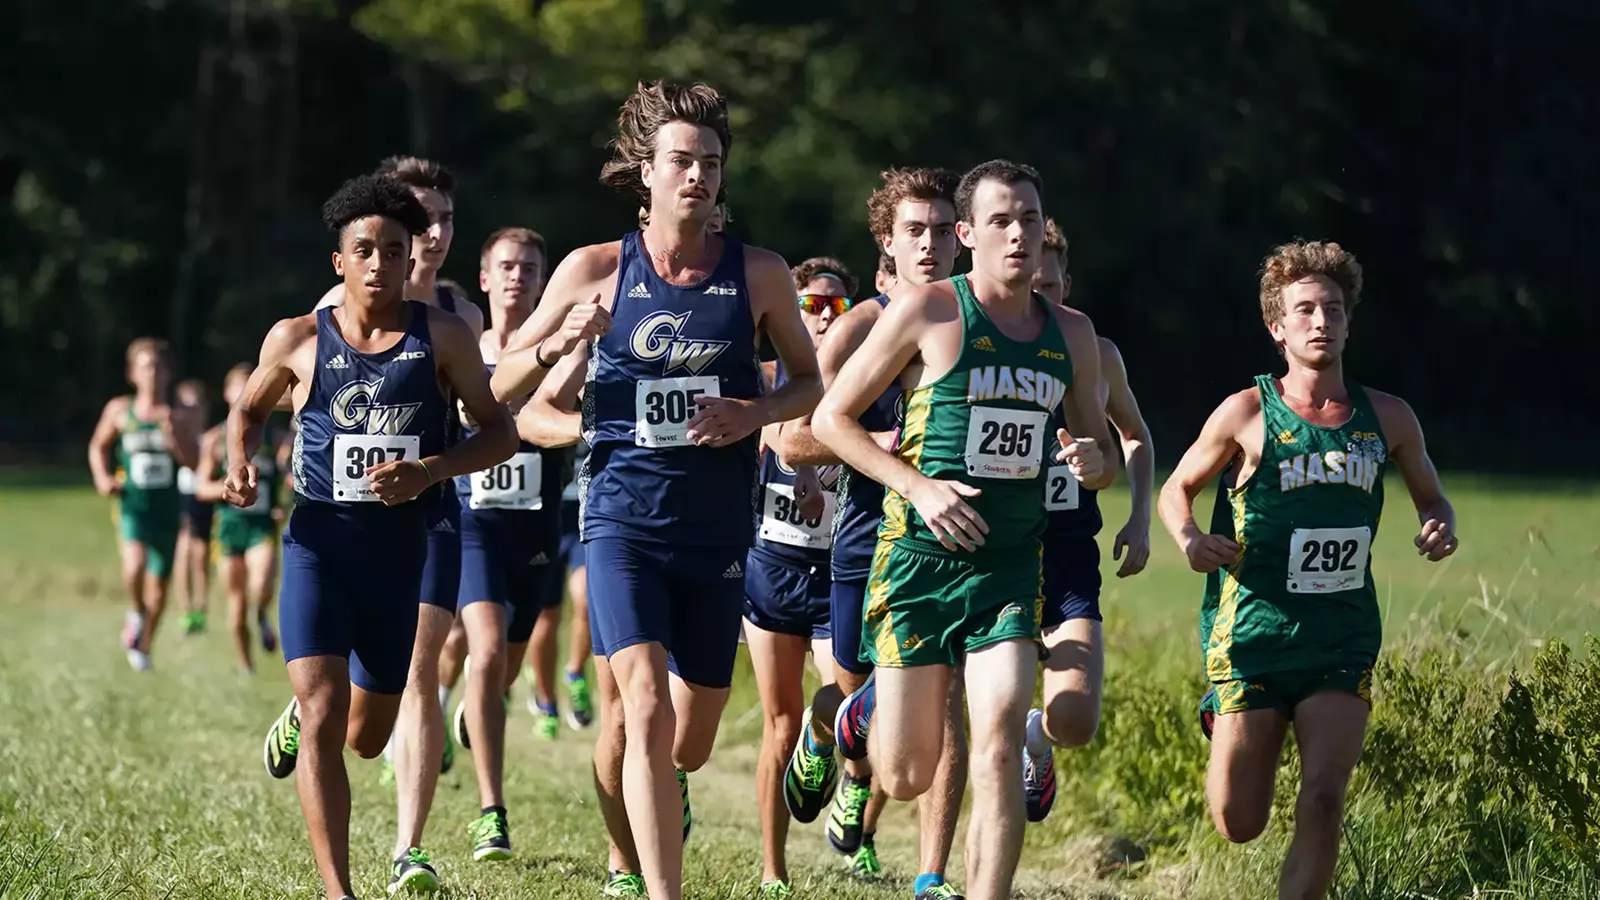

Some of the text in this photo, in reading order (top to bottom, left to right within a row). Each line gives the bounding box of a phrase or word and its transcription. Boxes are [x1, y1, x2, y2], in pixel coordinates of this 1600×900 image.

[628, 291, 652, 299] adidas
[629, 310, 732, 377] GW
[329, 376, 423, 436] GW
[645, 388, 706, 425] 305
[968, 365, 1067, 413] MASON
[978, 420, 1035, 457] 295
[481, 463, 526, 491] 301
[1278, 450, 1380, 495] MASON
[1301, 539, 1359, 573] 292
